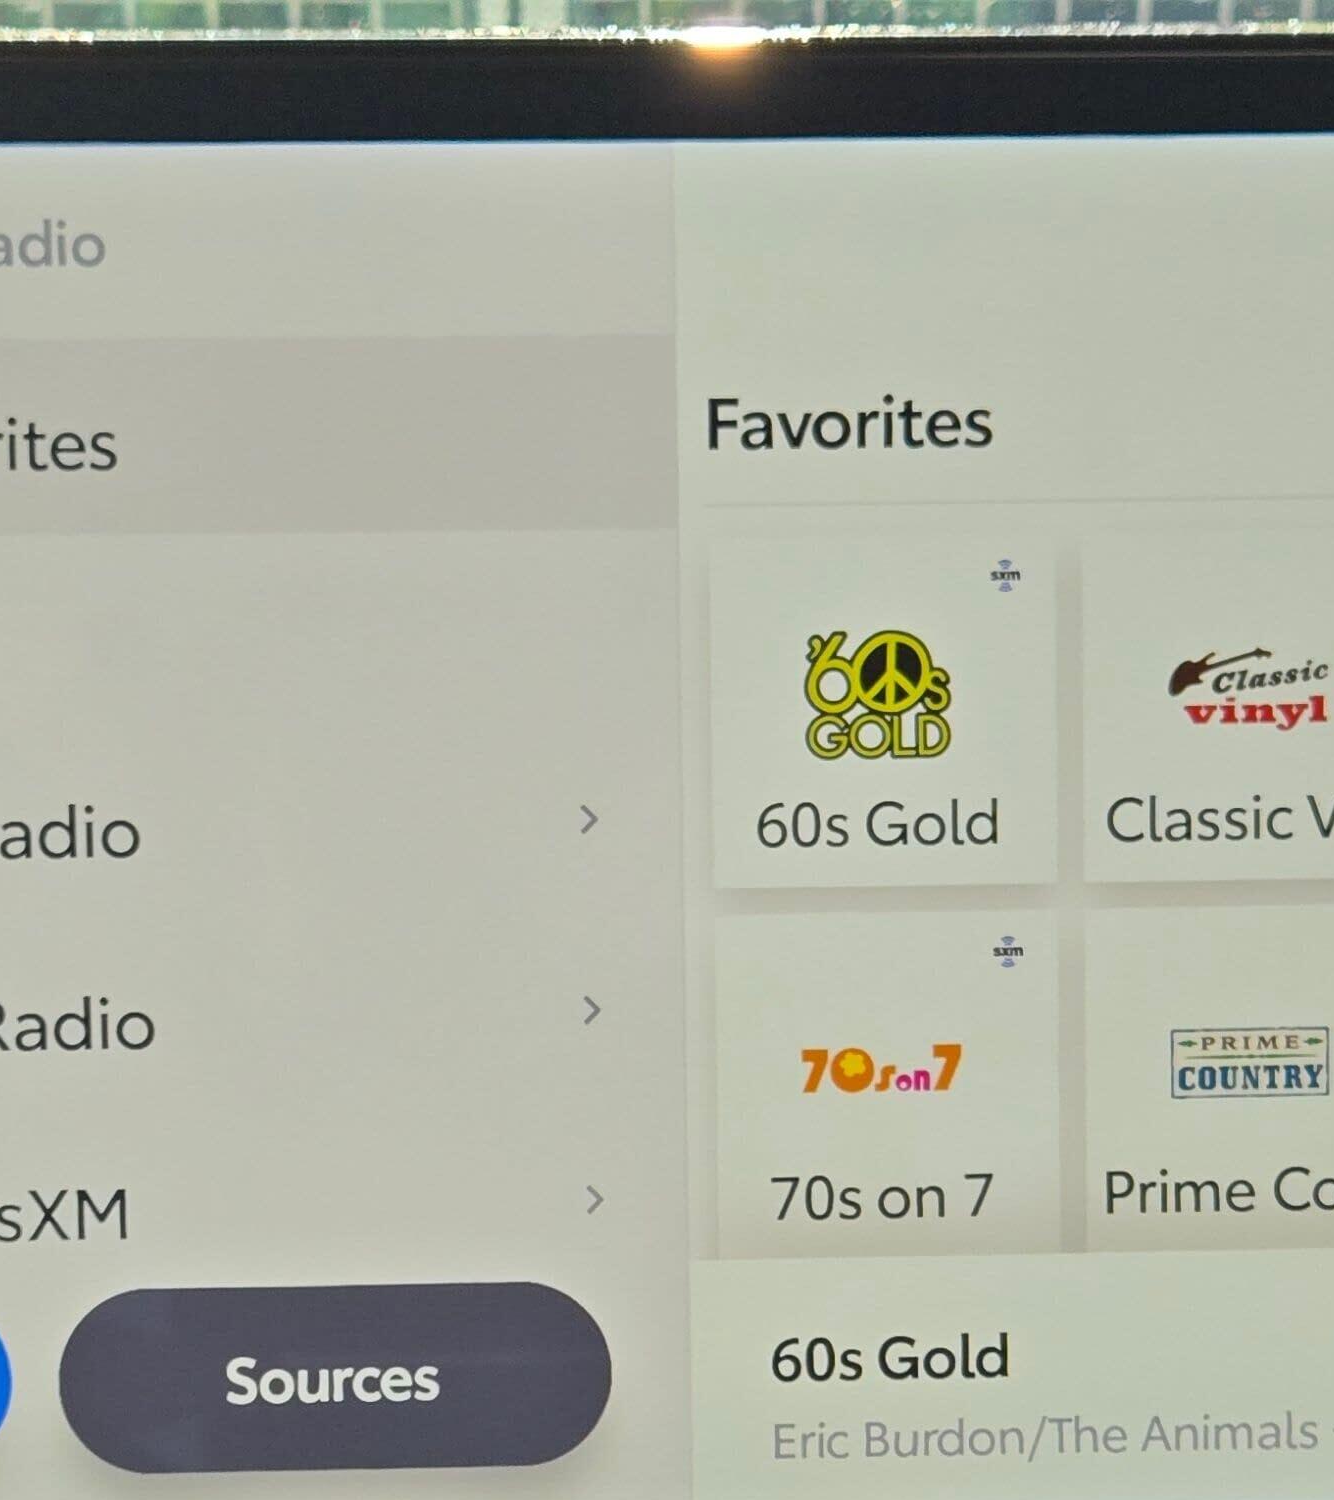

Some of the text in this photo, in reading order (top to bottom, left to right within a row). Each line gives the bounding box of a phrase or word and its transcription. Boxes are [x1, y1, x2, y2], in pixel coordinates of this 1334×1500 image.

[709, 394, 992, 449] Favorites
[1212, 659, 1330, 694] Classic
[805, 711, 952, 760] GOLD
[1183, 695, 1329, 731] vinyl
[758, 798, 997, 848] 60s Gold
[1107, 795, 1293, 842] Classic
[993, 946, 1024, 957] sxm
[1200, 1034, 1301, 1051] PRIME
[1178, 1063, 1324, 1092] COUNTRY
[771, 1173, 993, 1220] 70s on 7
[1107, 1169, 1255, 1214] Prime
[772, 1332, 1008, 1382] 60s Gold
[226, 1357, 439, 1405] Sources
[775, 1422, 849, 1459] Eric
[865, 1415, 1127, 1462] Burdon/The
[1141, 1411, 1318, 1451] Animals
